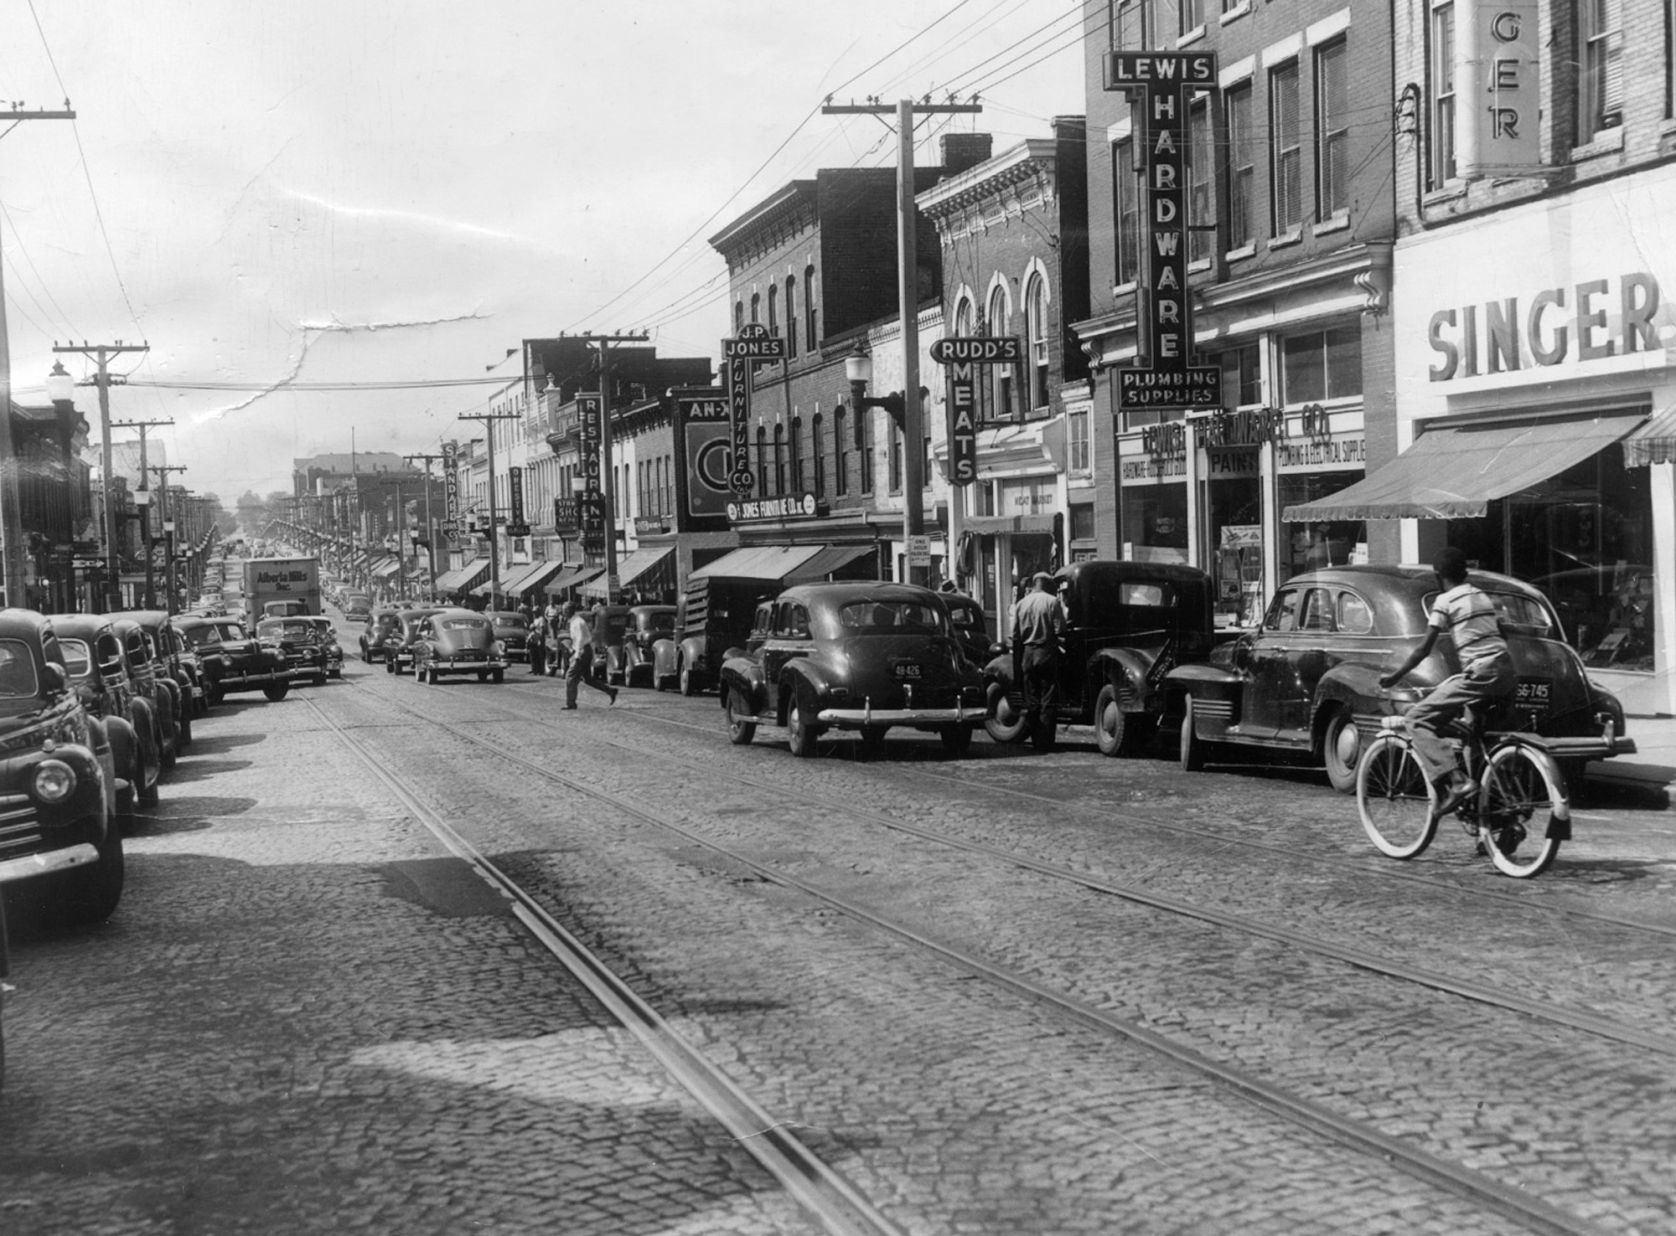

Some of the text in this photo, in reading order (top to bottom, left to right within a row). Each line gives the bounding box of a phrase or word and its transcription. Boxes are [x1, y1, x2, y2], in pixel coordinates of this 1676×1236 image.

[1117, 57, 1210, 80] LEWIS
[1154, 94, 1180, 358] HARDWARE
[727, 342, 780, 355] JONES
[742, 326, 765, 339] J.P.
[941, 341, 1016, 358] RUDD'S
[1428, 272, 1664, 383] SINGER
[1124, 372, 1216, 387] PLUMBING
[1128, 389, 1212, 403] SUPPLIES
[733, 358, 747, 470] FURNITURE
[953, 362, 974, 479] MEATS
[445, 445, 457, 520] STANDARD
[586, 400, 599, 528] RESTAURANT
